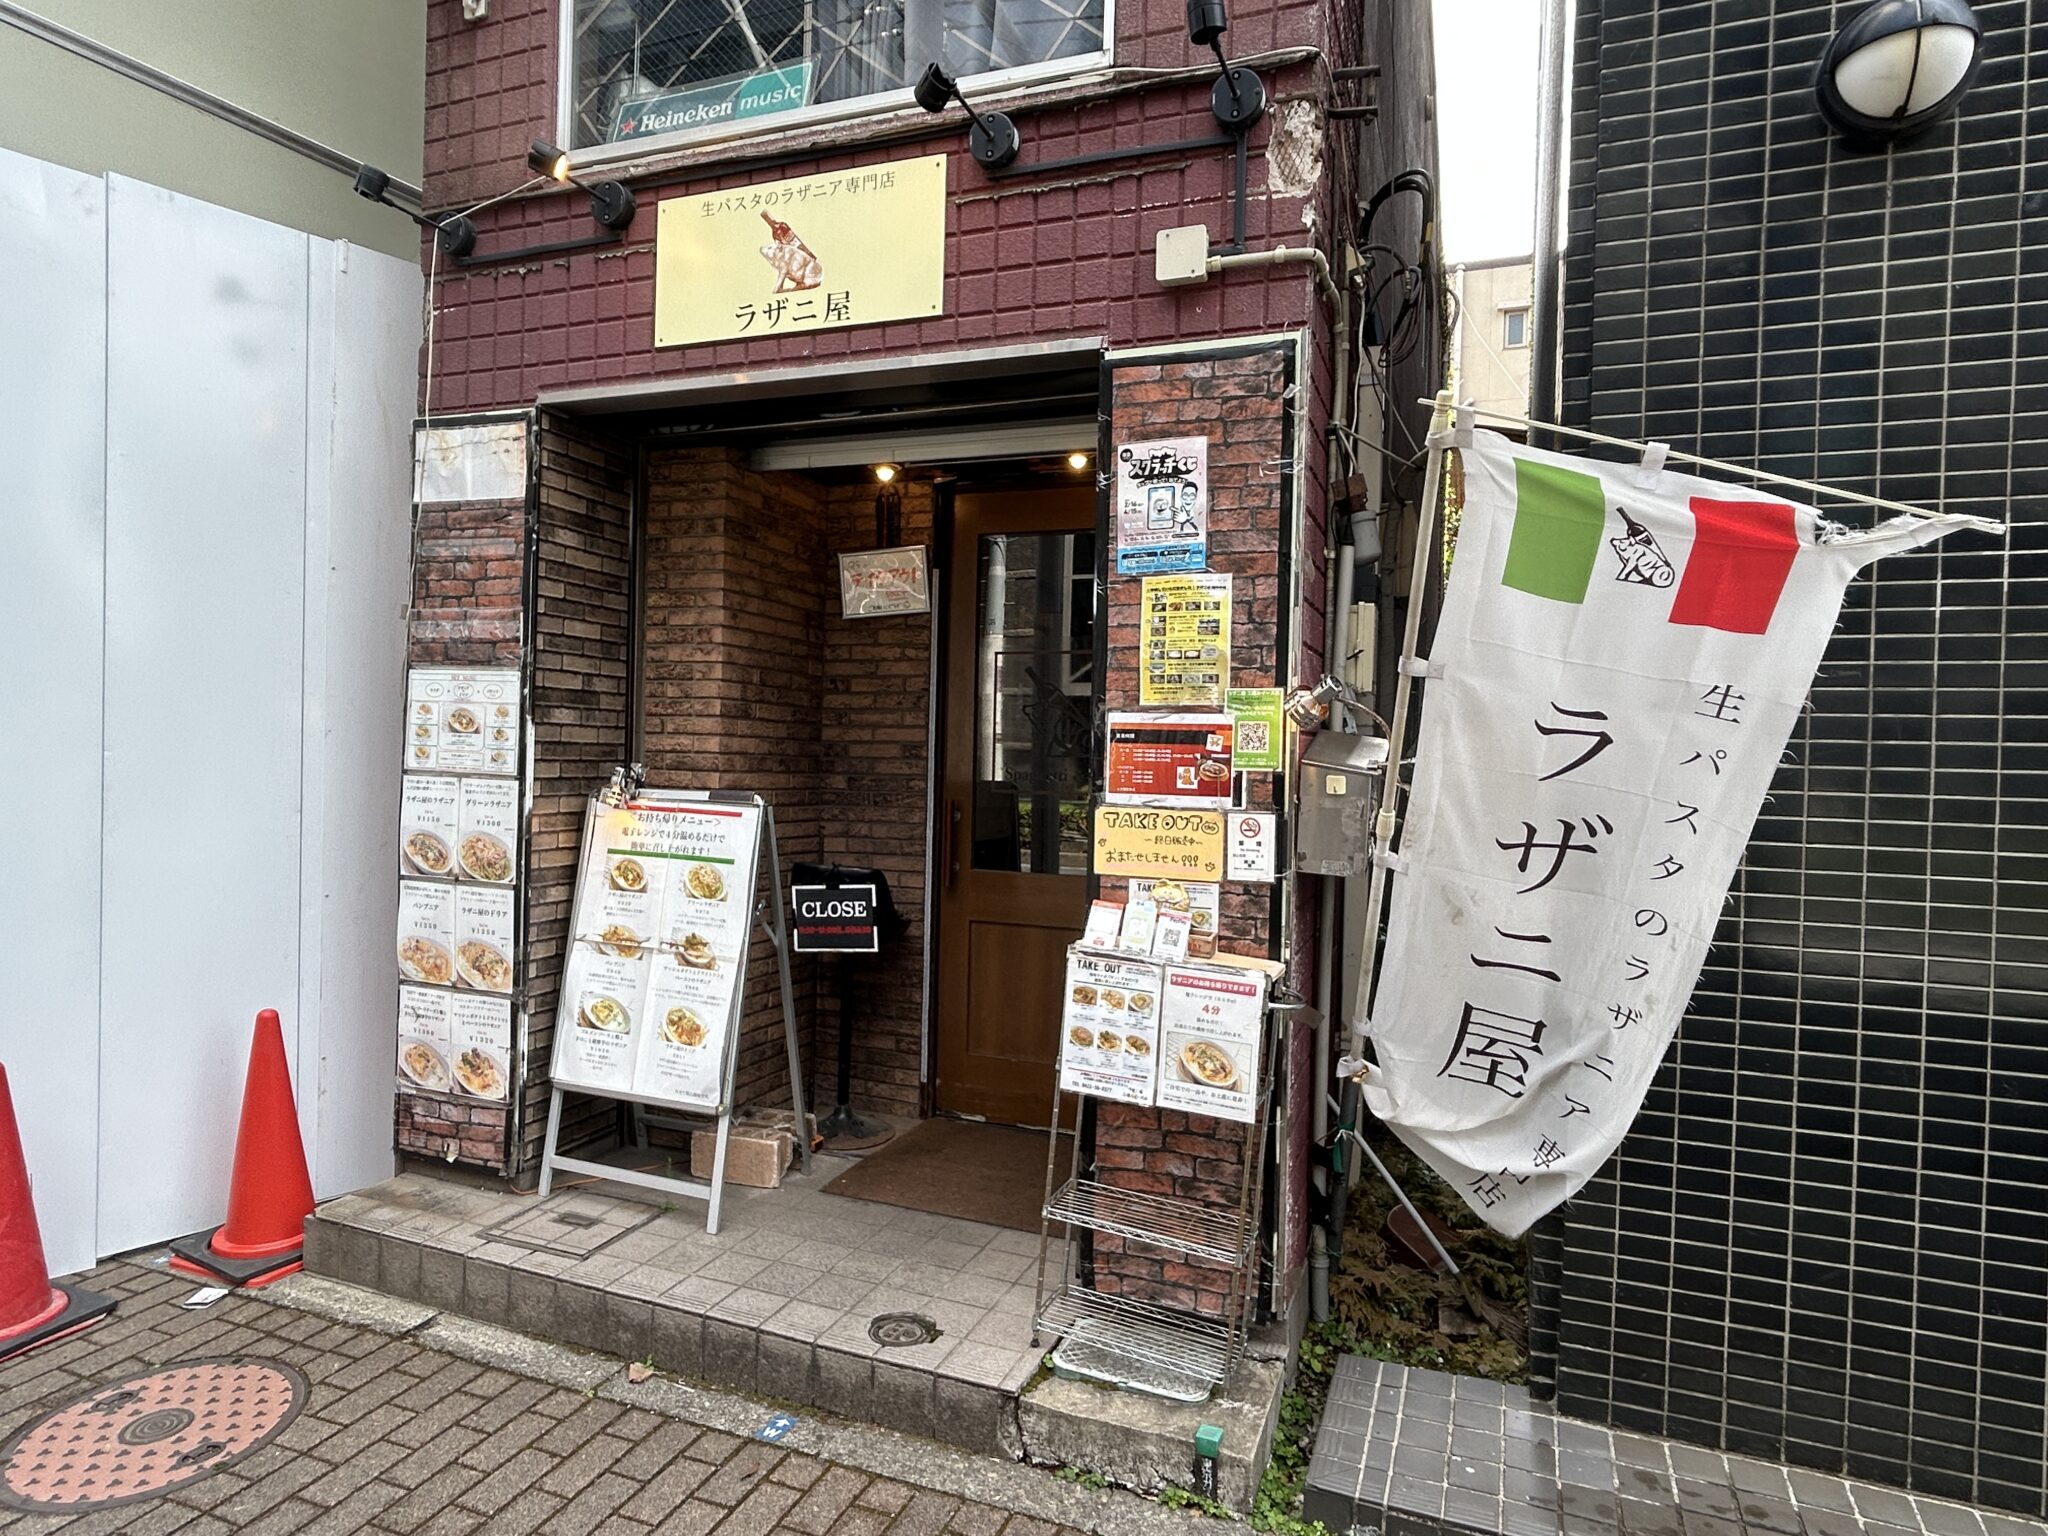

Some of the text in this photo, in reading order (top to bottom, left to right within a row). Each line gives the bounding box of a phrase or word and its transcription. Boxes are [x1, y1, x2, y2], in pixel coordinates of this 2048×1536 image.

[639, 84, 801, 132] Heineken music
[700, 171, 896, 217] 生パスタのラザニア専門店
[734, 290, 851, 331] ラザニ屋
[1130, 456, 1198, 475] スクラッチくじ
[466, 799, 512, 808] グリーンラザニア
[1103, 812, 1202, 832] TAKE OUT
[801, 901, 867, 917] CLOSE
[1436, 702, 1614, 1098] ラザニ屋
[1077, 960, 1122, 974] TAKE OUT
[1202, 1004, 1221, 1016] 4分
